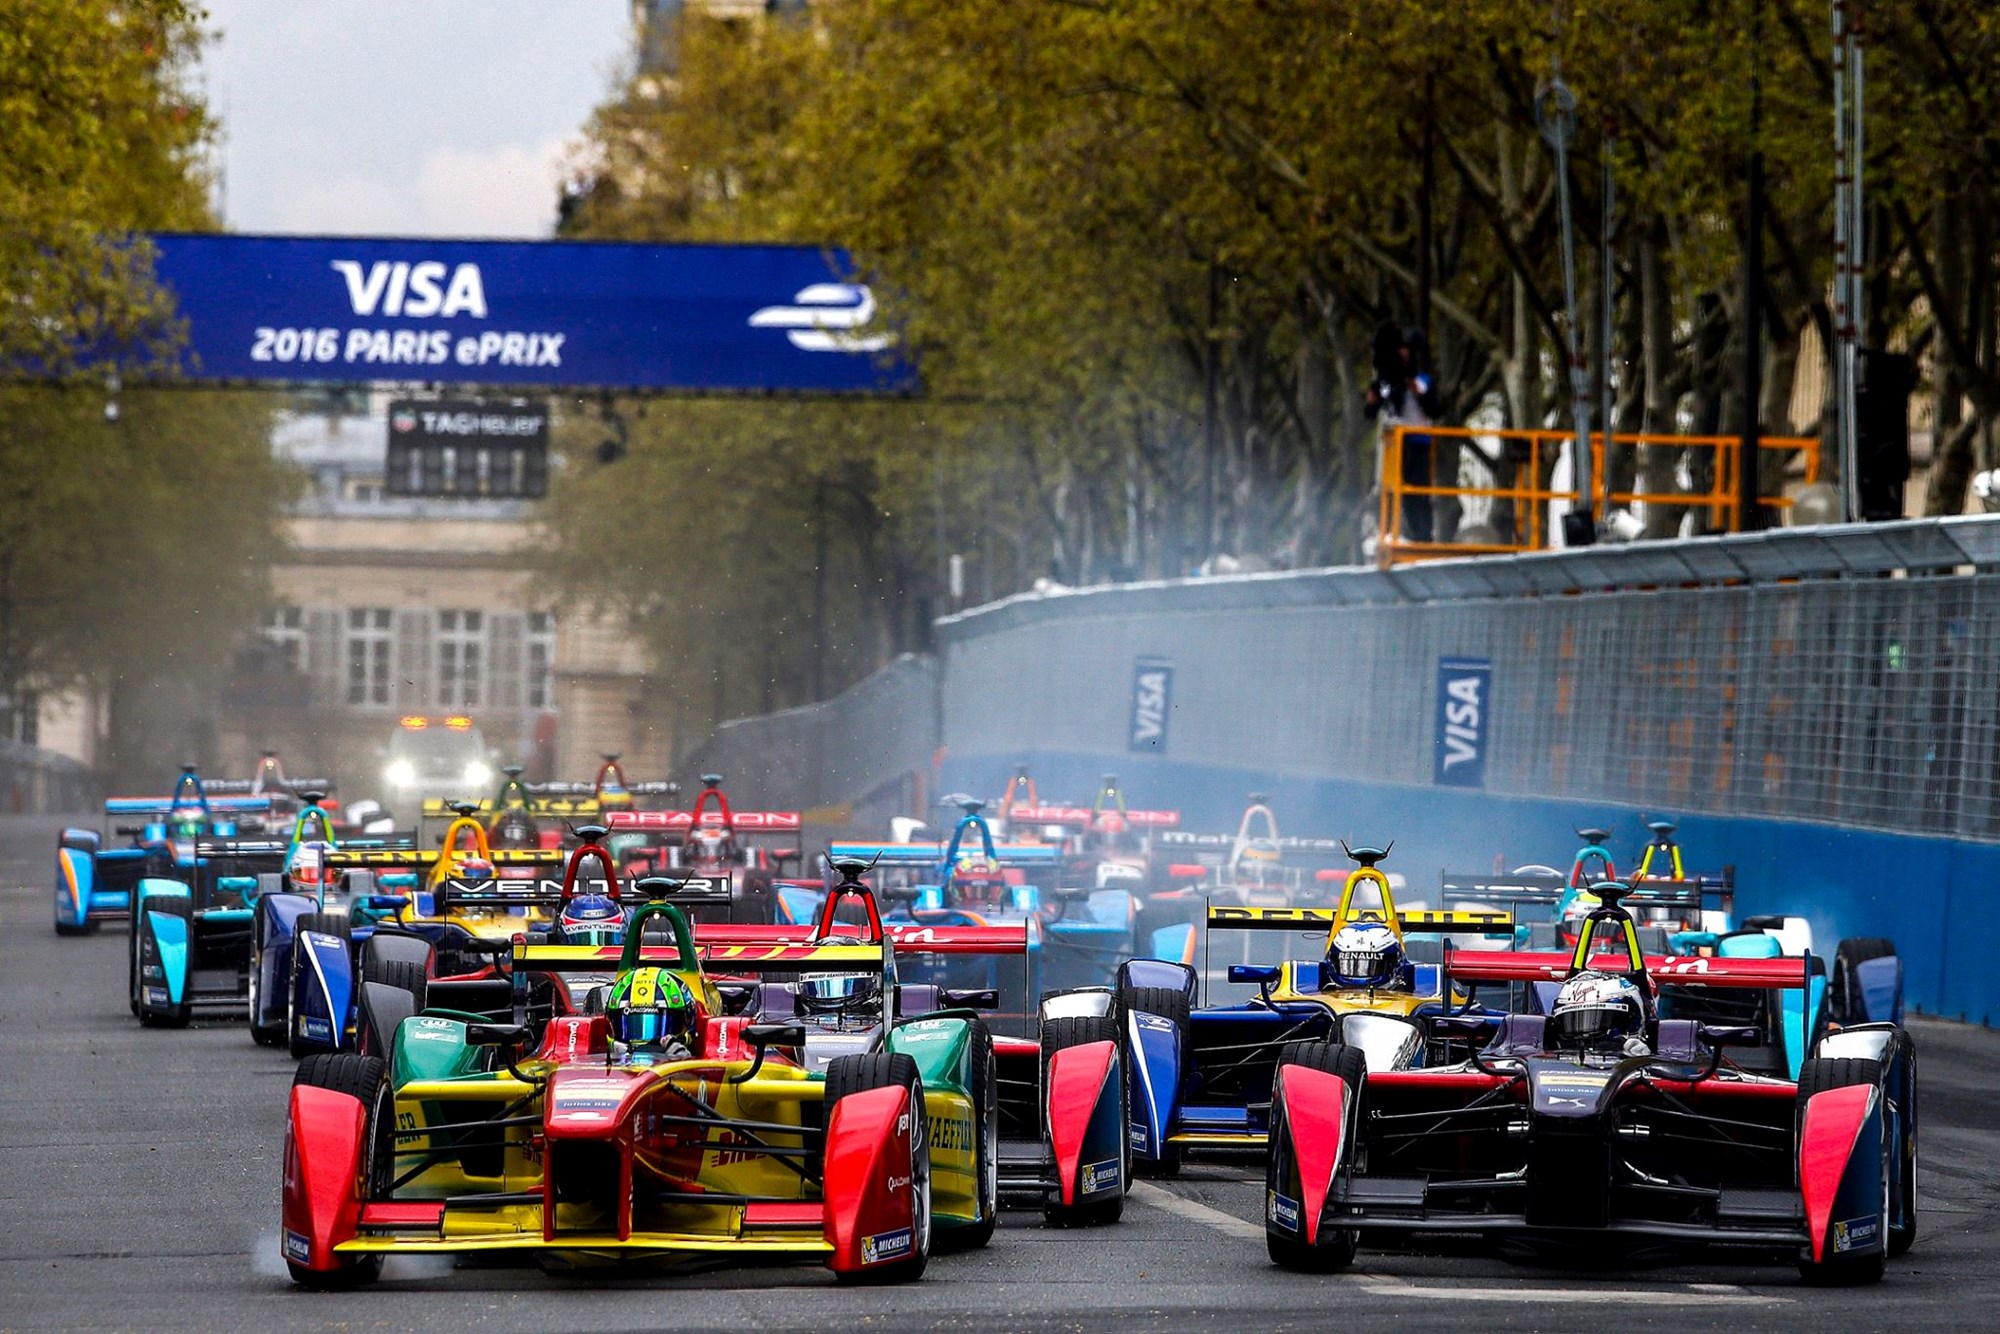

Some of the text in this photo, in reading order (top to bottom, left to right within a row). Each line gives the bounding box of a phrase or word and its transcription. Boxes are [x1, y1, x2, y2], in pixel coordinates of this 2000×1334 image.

[330, 260, 488, 318] VISA
[250, 327, 565, 366] 2016 PARIS ePRIX
[1137, 672, 1165, 738] VISA
[1443, 676, 1480, 771] VISA
[605, 811, 799, 824] DRAGON
[450, 878, 728, 893] VENTRI
[1339, 952, 1384, 960] RENAULT
[878, 1234, 910, 1252] MICHELIN
